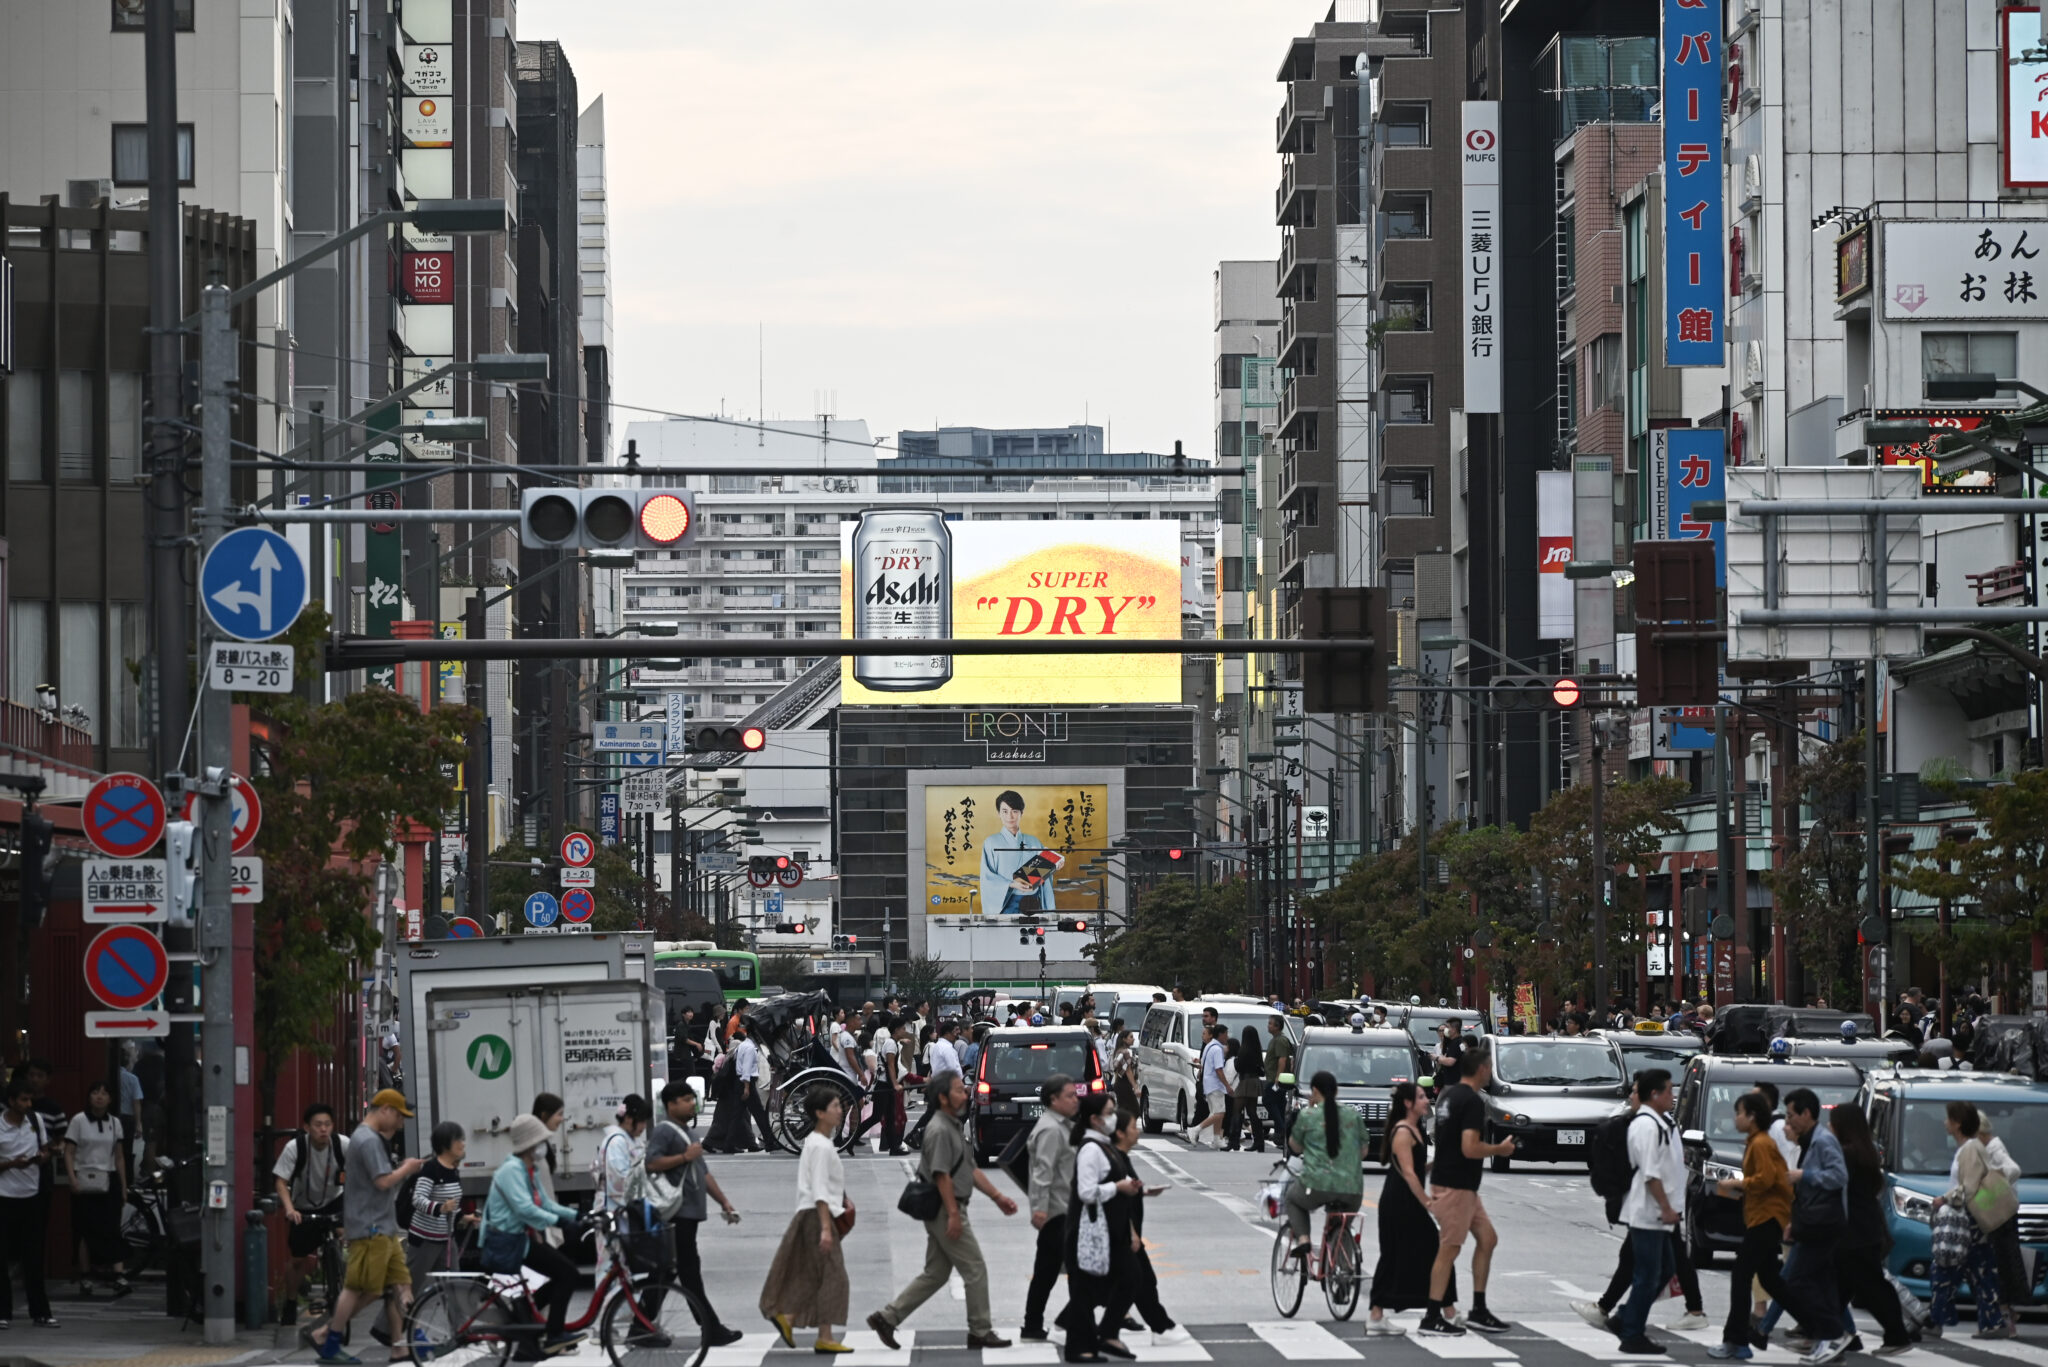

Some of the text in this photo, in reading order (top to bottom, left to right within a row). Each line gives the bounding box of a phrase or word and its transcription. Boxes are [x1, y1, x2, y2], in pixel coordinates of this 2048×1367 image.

[1466, 154, 1496, 162] MUFG
[1675, 0, 1713, 343] パーティー館
[1974, 228, 2040, 262] あん
[414, 257, 441, 270] MO
[415, 275, 441, 287] MO
[1471, 210, 1493, 357] 三菱UFJ銀行
[1898, 287, 1924, 303] 2F
[1543, 547, 1571, 565] JTB
[1028, 571, 1109, 588] SUPER
[865, 572, 940, 605] Asahi
[894, 611, 913, 624] 生
[216, 649, 289, 666] 路線バスを除く
[671, 694, 681, 750] スクランブル式
[969, 712, 1063, 737] FRONT
[605, 726, 653, 739] 雷門
[599, 740, 657, 748] Kaminarimon Gate
[1011, 737, 1020, 746] of
[990, 747, 1043, 759] asakusa
[960, 796, 976, 851] かねふくの
[944, 807, 957, 866] めんたいこ
[88, 865, 163, 881] 人の乗降を除く
[781, 869, 798, 881] 40
[942, 896, 968, 904] かねふく
[532, 902, 545, 923] P
[541, 913, 551, 923] 60
[565, 1047, 632, 1063] 西原商会
